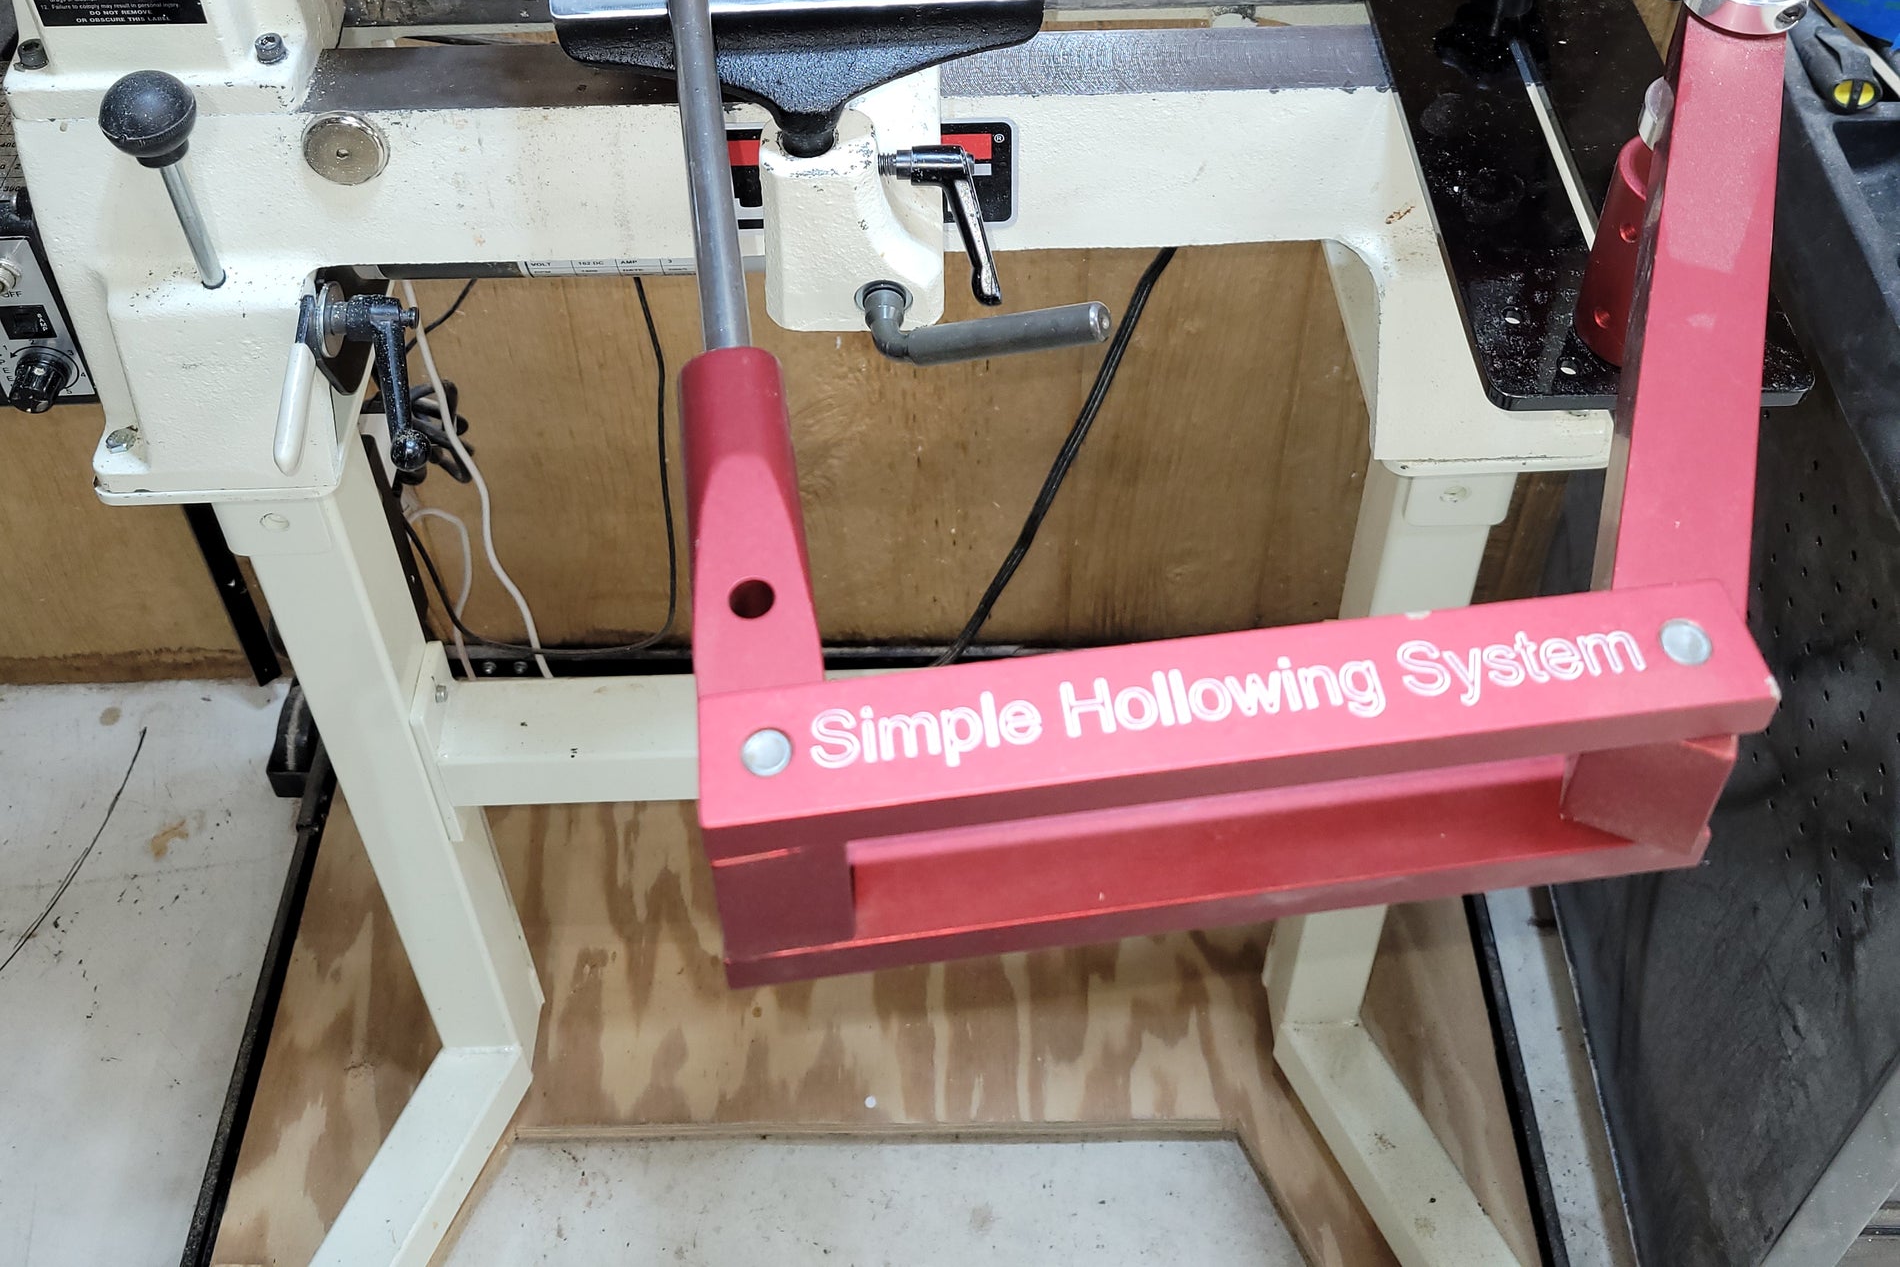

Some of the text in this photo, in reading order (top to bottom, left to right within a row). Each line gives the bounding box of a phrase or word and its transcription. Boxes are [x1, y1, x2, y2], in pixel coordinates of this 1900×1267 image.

[809, 628, 1647, 768] Simple Hollowing System
